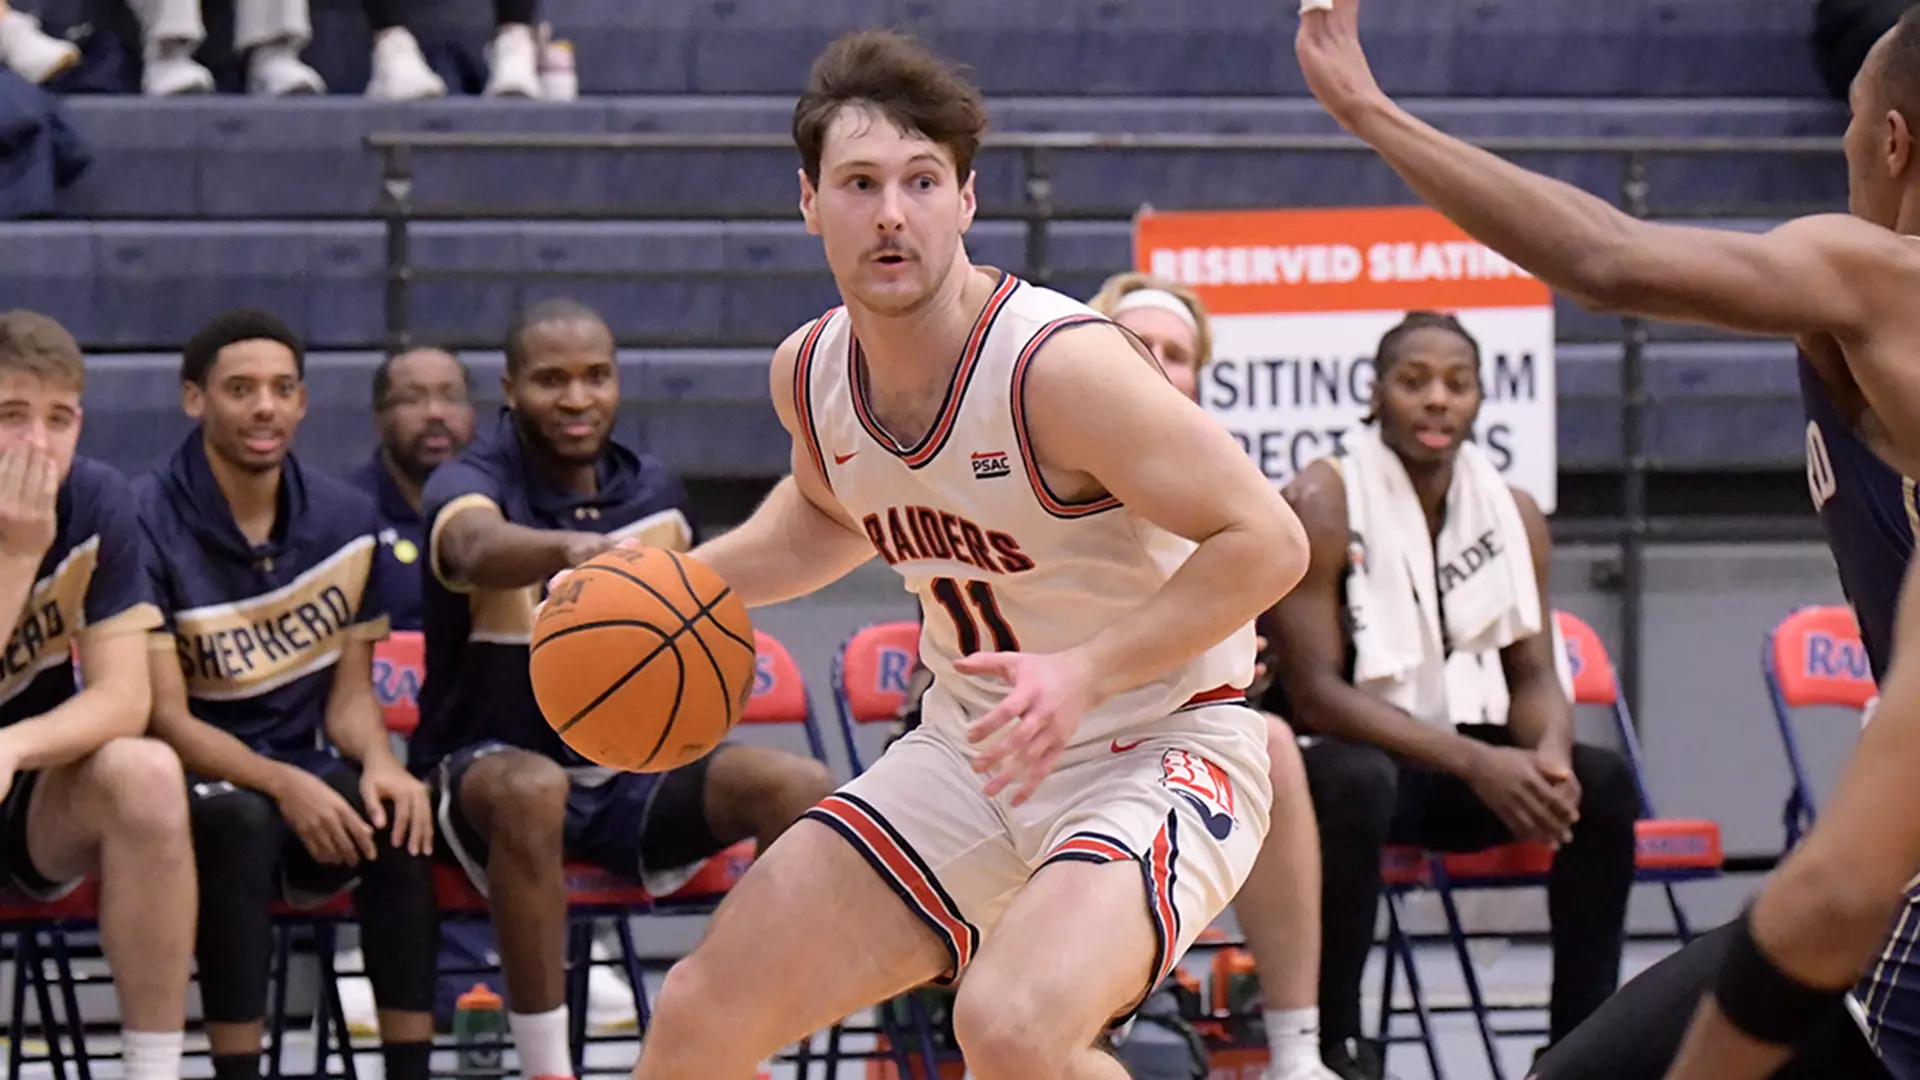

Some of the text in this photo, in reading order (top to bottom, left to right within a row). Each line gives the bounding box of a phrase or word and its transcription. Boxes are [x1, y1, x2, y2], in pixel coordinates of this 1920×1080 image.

[1151, 244, 1363, 286] RESERVED
[1197, 357, 1374, 410] SITING
[972, 457, 1010, 473] PSAC
[863, 505, 1036, 574] RAIDERS
[1440, 529, 1504, 592] ADE
[175, 584, 353, 679] SHEPHERD
[931, 577, 1021, 657] 11
